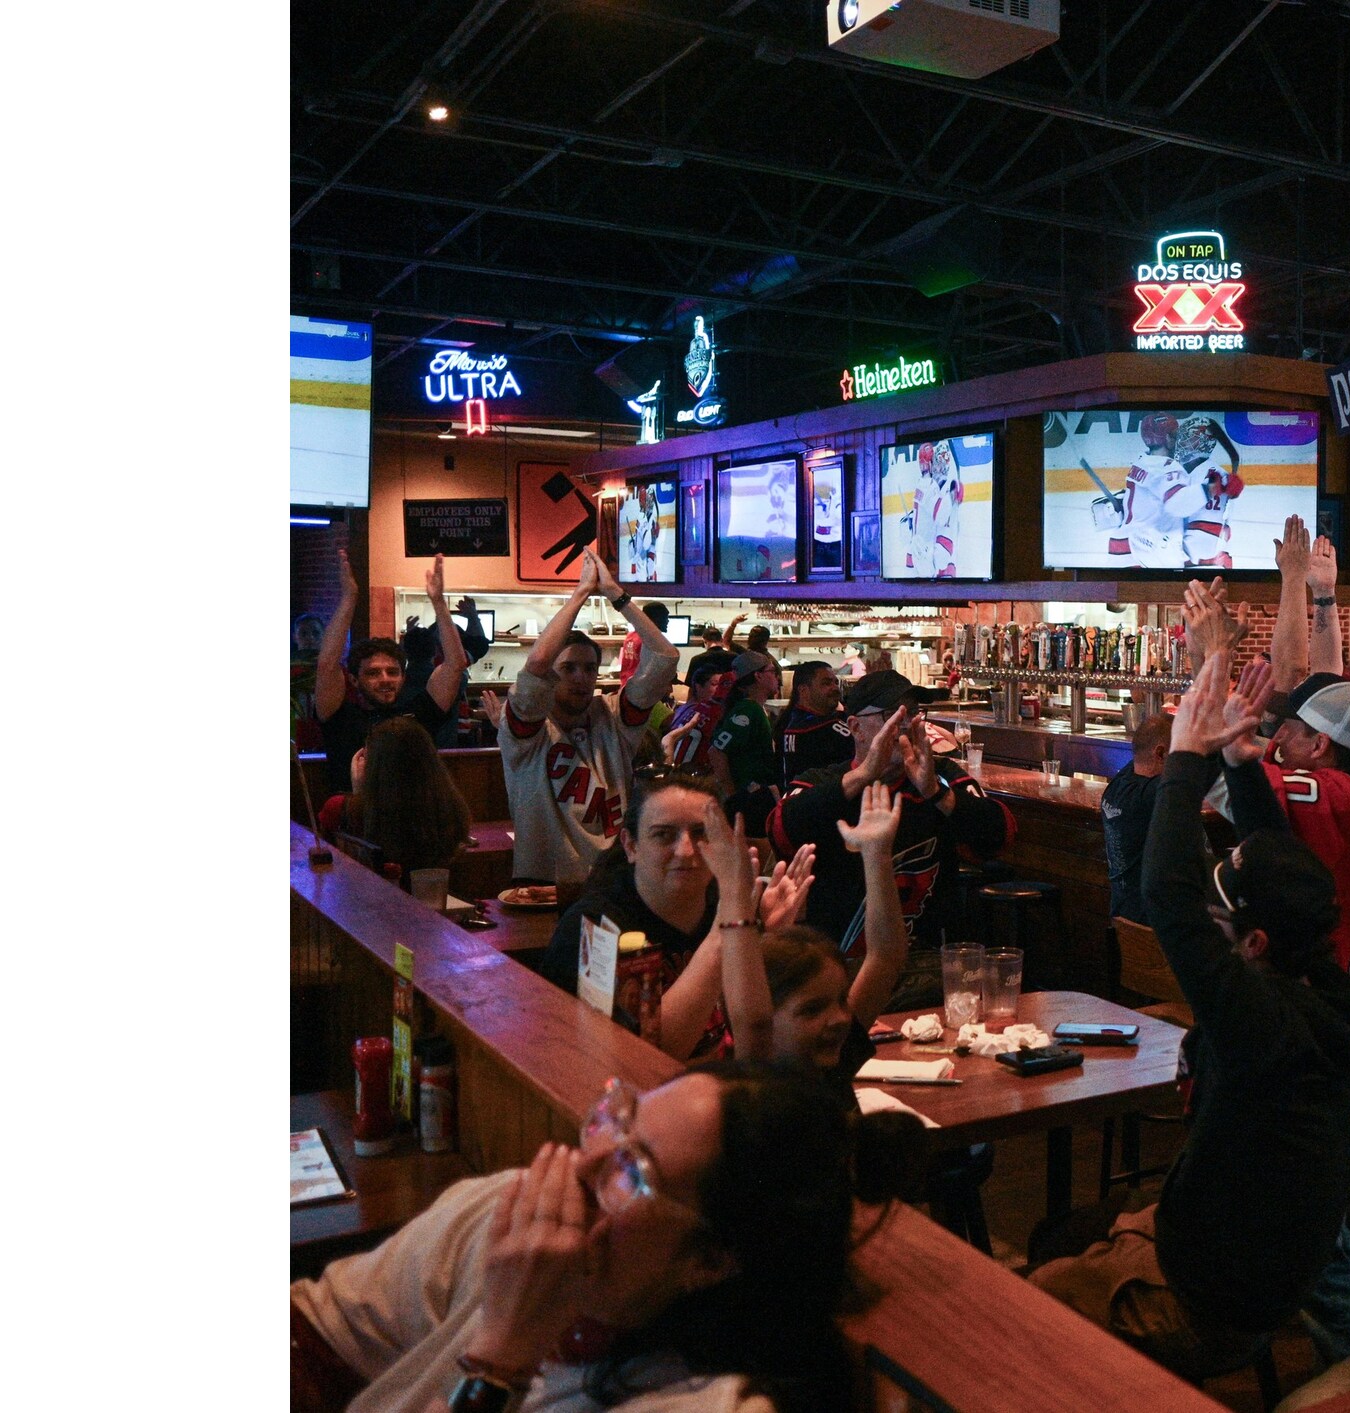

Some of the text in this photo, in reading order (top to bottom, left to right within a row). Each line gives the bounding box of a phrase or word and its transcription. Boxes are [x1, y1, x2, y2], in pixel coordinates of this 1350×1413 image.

[1166, 244, 1214, 258] ON TAP
[1137, 262, 1242, 284] DOS EQUIS
[1133, 282, 1246, 333] XX
[1136, 334, 1244, 353] IMPORTED BEER
[425, 370, 522, 402] ULTRA
[853, 356, 936, 399] Heineken
[408, 506, 503, 517] EMPLOYEES ONLY
[420, 516, 491, 528] BEYOND THIS
[440, 527, 473, 538] POINT
